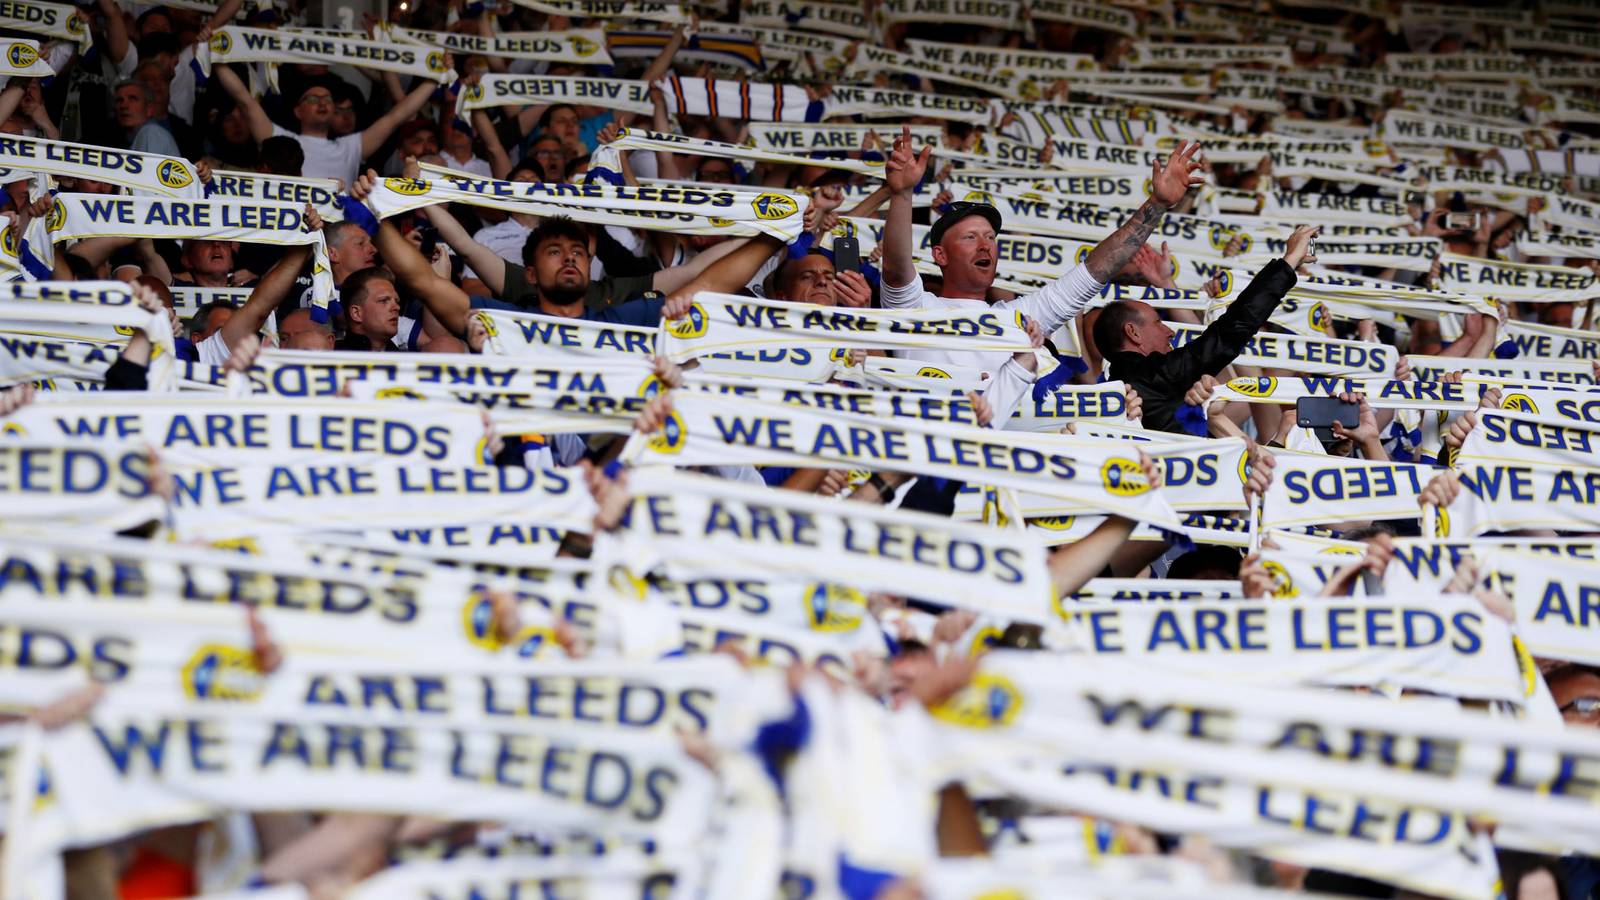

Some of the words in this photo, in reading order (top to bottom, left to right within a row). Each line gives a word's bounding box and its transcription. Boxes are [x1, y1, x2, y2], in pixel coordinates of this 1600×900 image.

[0, 3, 57, 25] EEDS
[779, 1, 810, 18] AE
[820, 9, 866, 27] LEED
[243, 33, 281, 50] WE
[288, 37, 335, 56] ARE
[342, 44, 415, 65] LEEDS
[446, 37, 488, 50] ARE
[495, 39, 561, 53] LEEDS
[866, 49, 905, 64] WE
[923, 46, 953, 64] WE
[1401, 58, 1425, 70] WE
[1433, 58, 1468, 71] ARE
[494, 80, 567, 97] LEEDS
[576, 82, 622, 98] ARE
[833, 89, 866, 103] WE
[873, 92, 913, 108] ARE
[922, 98, 988, 113] LEEDS
[765, 131, 805, 148] WE
[811, 131, 858, 148] ARE
[1395, 120, 1425, 136] WE
[1432, 122, 1469, 140] ARE
[1477, 127, 1523, 147] LEED
[0, 137, 36, 158] RE
[46, 143, 143, 174] LEEDS
[997, 145, 1041, 163] EDS
[1053, 140, 1088, 160] WE
[1096, 147, 1138, 165] ARE
[210, 176, 253, 198] ARE
[1054, 176, 1131, 195] LEEDS
[1453, 167, 1494, 183] ARE
[1503, 173, 1567, 195] LEEDS
[617, 187, 734, 207] LEEDS
[1274, 191, 1308, 208] WE
[1317, 195, 1361, 212] ARE
[1368, 199, 1406, 216] LEE
[1561, 199, 1593, 217] WE
[81, 200, 135, 224] WE
[144, 202, 211, 227] ARE
[1008, 198, 1049, 218] WE
[1057, 206, 1108, 227] ARE
[997, 240, 1063, 265] EEDS
[1364, 241, 1438, 260] LEEDS
[1547, 234, 1595, 248] ARE
[1479, 267, 1528, 287] ARE
[1536, 272, 1595, 290] LEED
[513, 319, 582, 347] WE
[725, 305, 791, 329] WE
[803, 310, 879, 332] ARE
[889, 313, 1004, 337] LEEDS
[0, 338, 69, 362] WE
[1247, 336, 1279, 358] RE
[1287, 340, 1387, 373] LEEDS
[1508, 334, 1552, 357] WE
[1559, 339, 1600, 359] AR
[1380, 380, 1465, 401] ARE
[783, 389, 875, 415] ARE
[892, 396, 977, 424] LEE
[1034, 391, 1125, 418] LEED
[163, 414, 269, 449] ARE
[290, 415, 451, 460] LEEDS
[1481, 414, 1593, 453] EEDS
[713, 415, 795, 451] WE
[812, 423, 910, 460] ARE
[924, 434, 1077, 480] LEEDS
[266, 466, 377, 500] ARE
[397, 467, 571, 495] LEEDS
[1284, 465, 1422, 504] LEEDS
[1458, 465, 1535, 503] WE
[1549, 470, 1600, 505] AR
[389, 525, 470, 546] WE
[488, 525, 566, 546] AR
[704, 502, 817, 547] ARE
[840, 514, 1023, 584] LEEDS
[0, 556, 148, 596] ARE
[178, 562, 420, 624] LEEDS
[1535, 580, 1600, 627] AR
[1076, 611, 1122, 653] E
[1147, 609, 1269, 652] ARE
[1291, 607, 1483, 655] LEEDS
[304, 675, 448, 711] ARE
[482, 673, 714, 730] LEEDS
[1084, 693, 1238, 746] WE
[1266, 719, 1458, 778] ARE
[92, 716, 229, 777] WE
[261, 718, 417, 774] ARE
[450, 729, 680, 823] LEEDS
[1257, 785, 1478, 864] LEED
